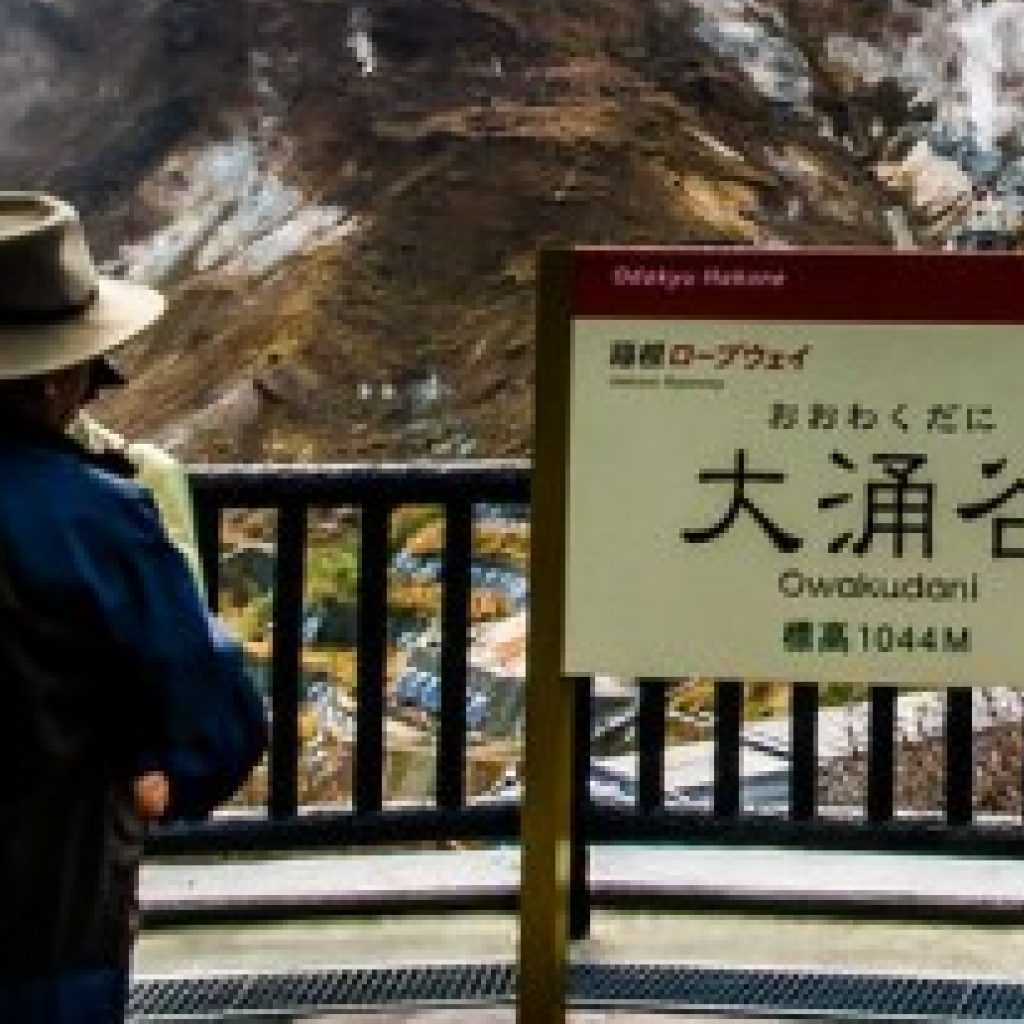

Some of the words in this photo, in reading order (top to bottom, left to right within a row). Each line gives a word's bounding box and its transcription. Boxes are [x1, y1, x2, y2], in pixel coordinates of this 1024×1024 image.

[767, 403, 997, 433] おおわくだに
[777, 568, 979, 603] Owakudani
